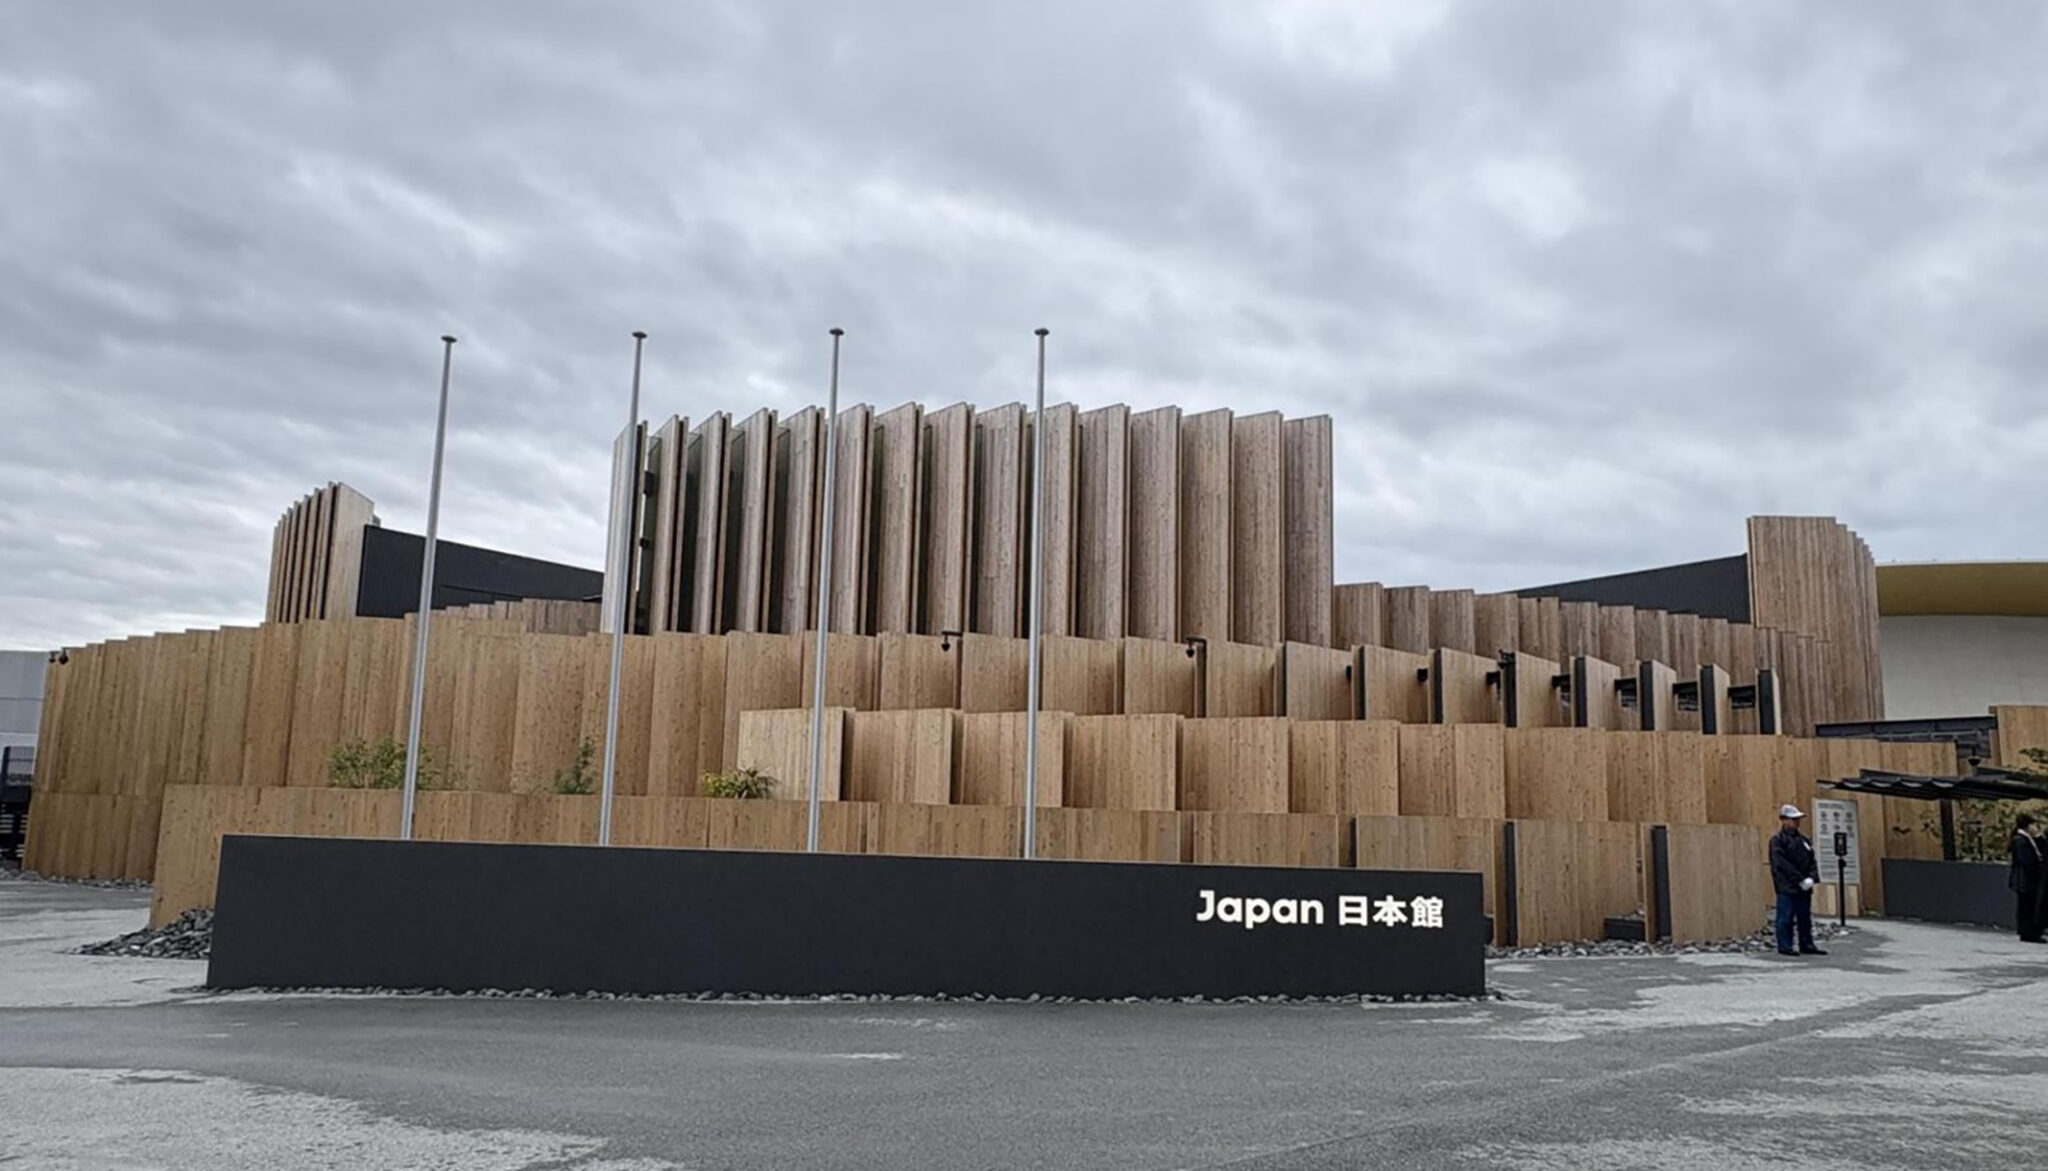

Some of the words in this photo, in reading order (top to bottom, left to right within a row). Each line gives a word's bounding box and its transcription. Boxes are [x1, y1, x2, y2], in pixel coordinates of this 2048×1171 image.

[1197, 889, 1324, 928] Japan
[1338, 895, 1444, 928] 日本館
